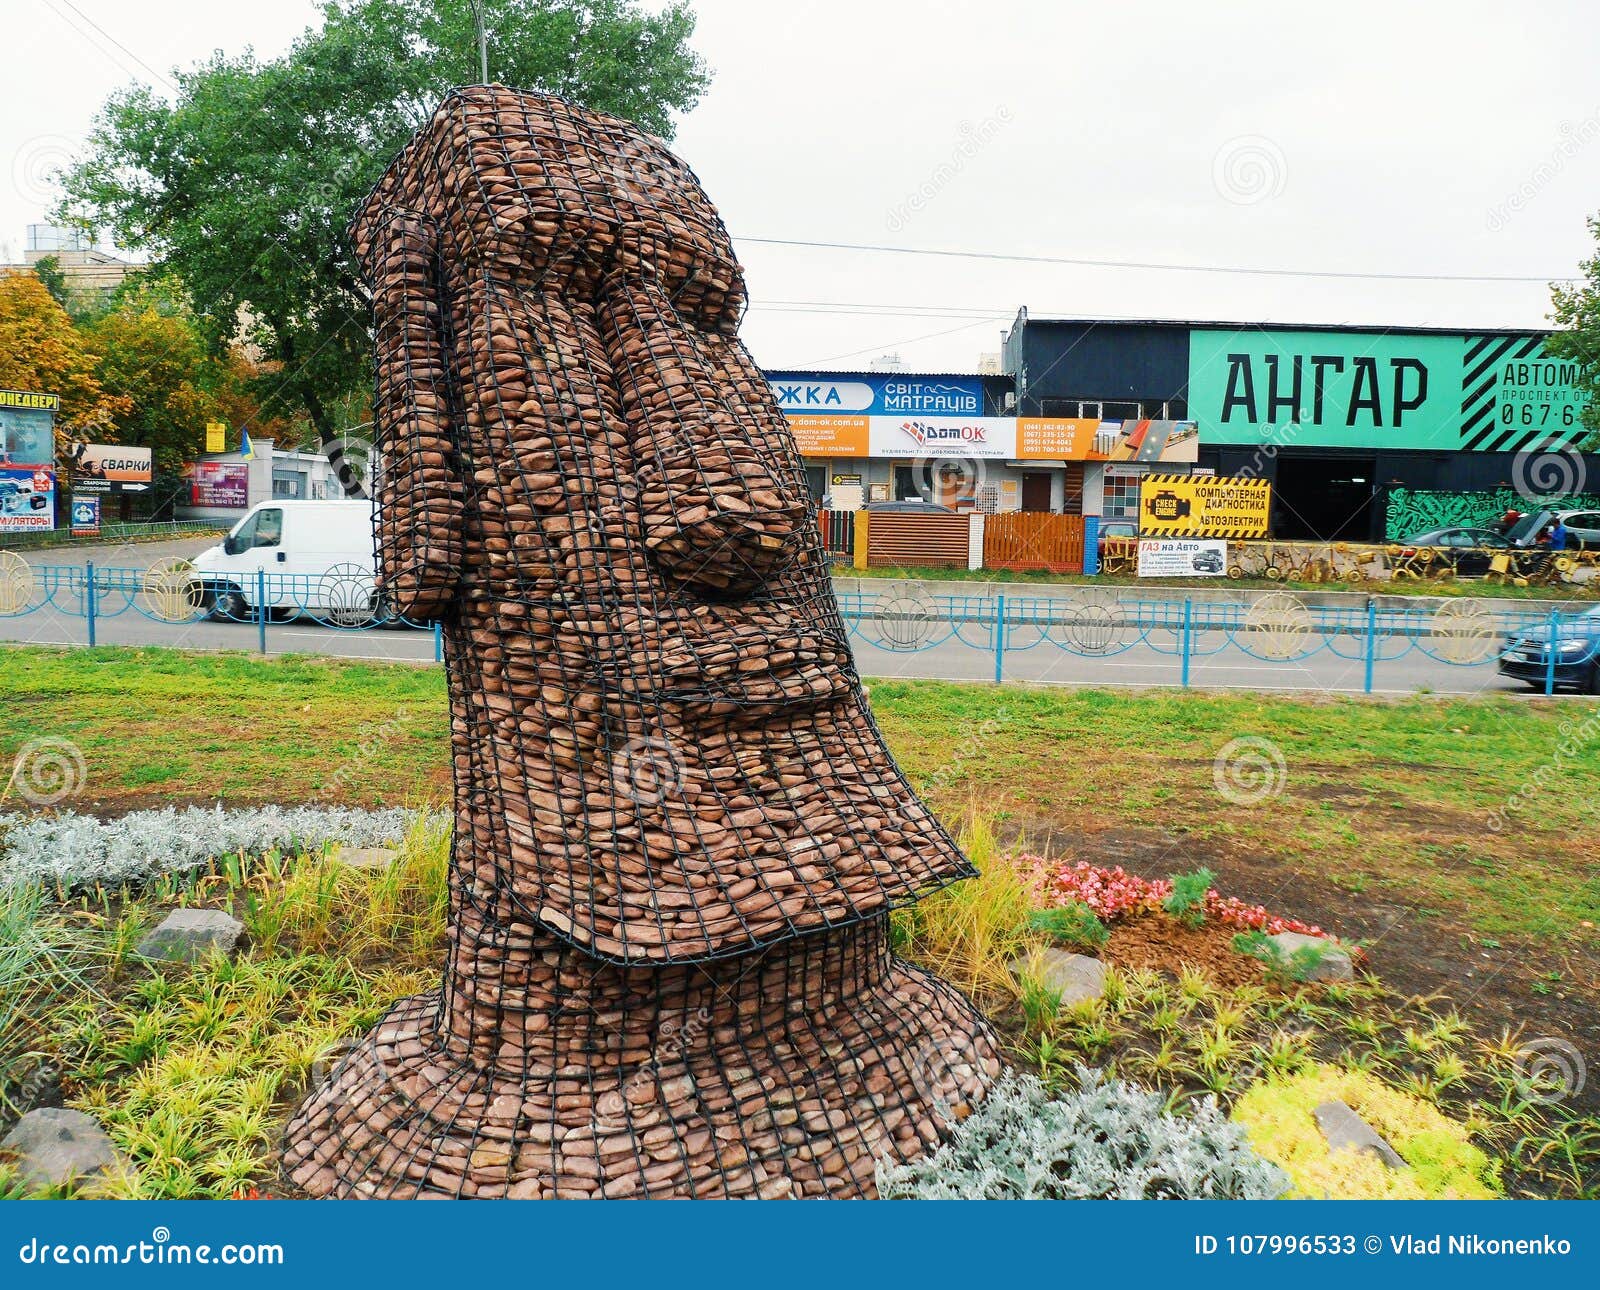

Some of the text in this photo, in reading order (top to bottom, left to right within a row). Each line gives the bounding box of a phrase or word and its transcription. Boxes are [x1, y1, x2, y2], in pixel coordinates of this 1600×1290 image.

[885, 383, 923, 395] СВІТ
[1220, 353, 1428, 428] АНГАР
[1502, 389, 1566, 401] ПРОСПЕКТ
[884, 395, 977, 413] МАТРАЦІВ
[101, 459, 150, 472] СВАРКИ
[1195, 487, 1266, 500] КОМПЬЮТЕРНАЯ
[1155, 499, 1177, 508] CHECK
[1204, 498, 1265, 511] ДИАГНОСТИКА
[1199, 515, 1264, 528] АВТОЭЛЕКТРИК
[1141, 542, 1160, 551] ГАЗ
[1176, 542, 1200, 551] Авто
